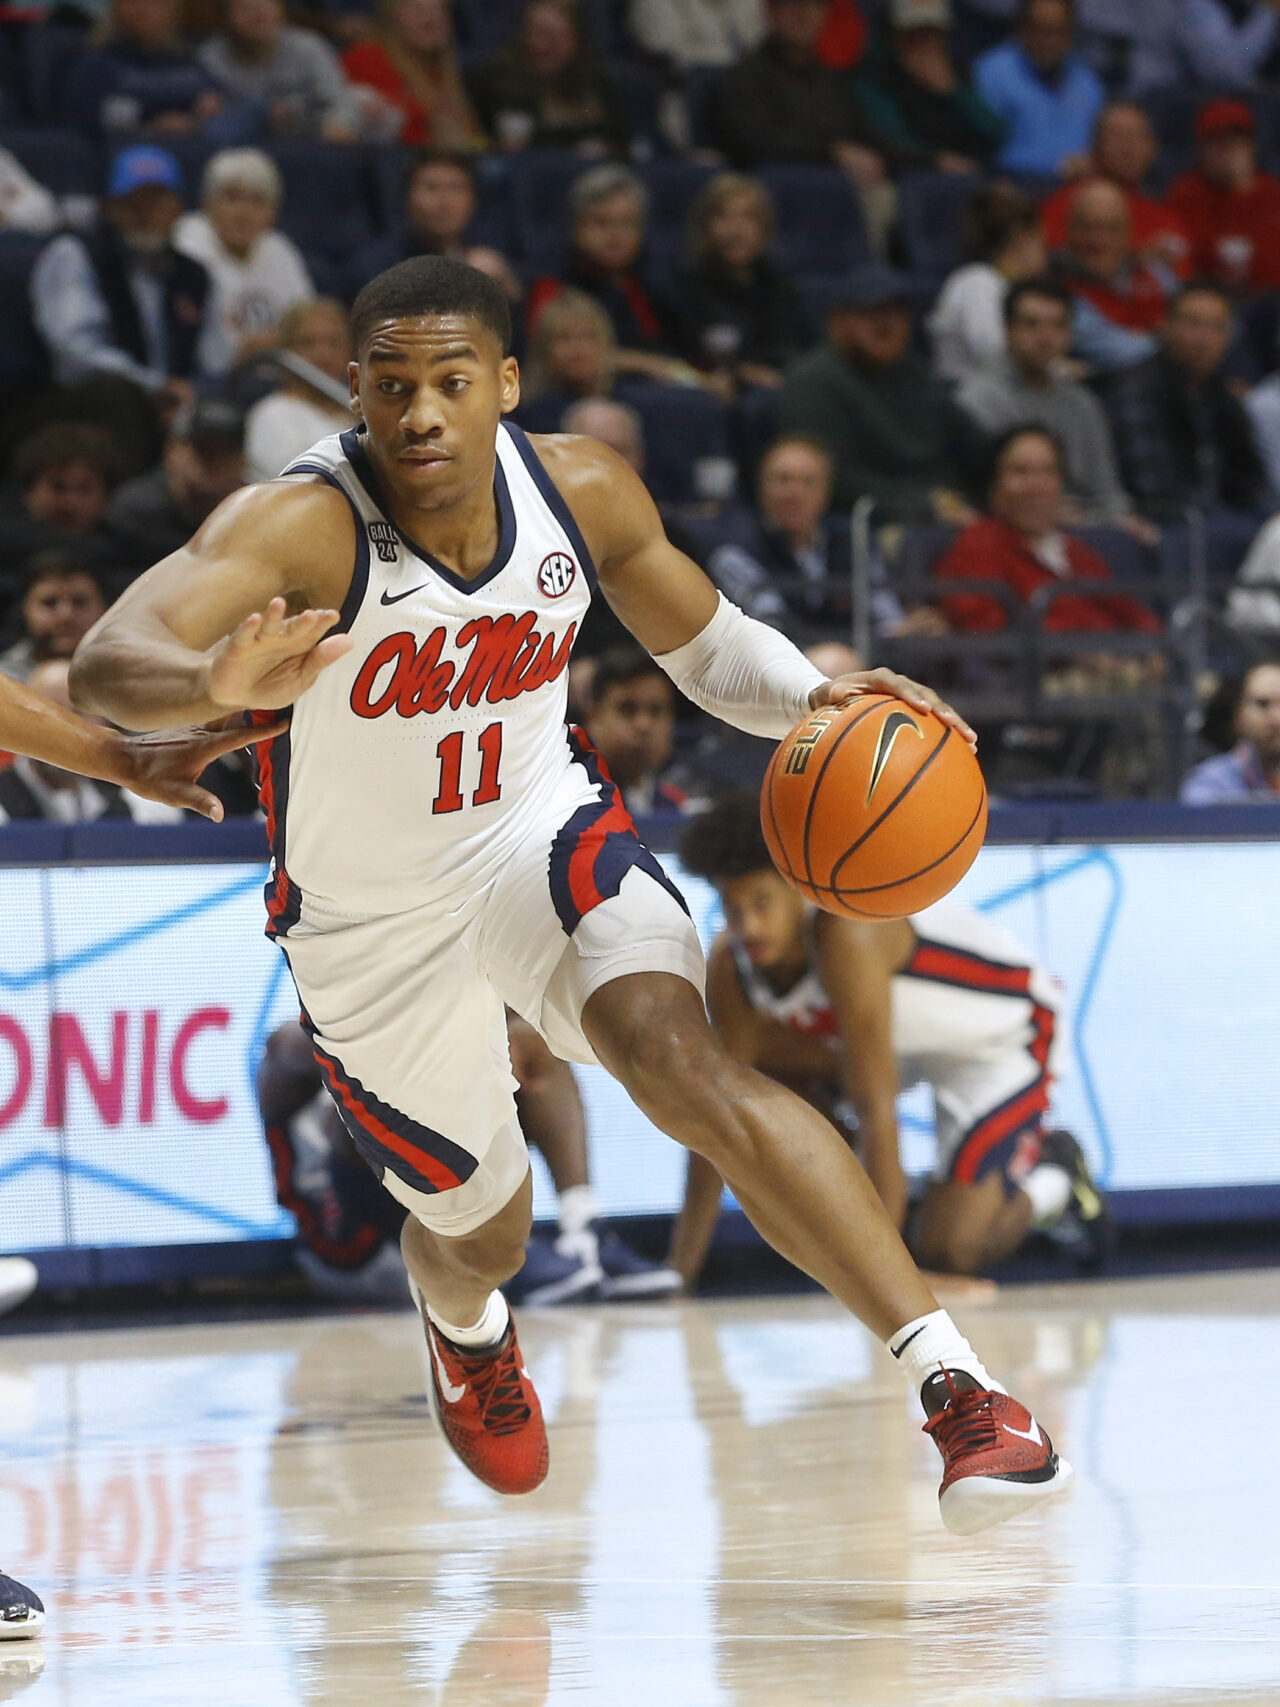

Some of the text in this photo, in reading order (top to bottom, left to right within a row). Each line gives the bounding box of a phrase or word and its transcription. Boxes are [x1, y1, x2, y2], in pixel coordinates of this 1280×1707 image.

[377, 542, 395, 560] 24
[539, 554, 574, 597] SEC
[350, 610, 577, 719] Ole Miss
[432, 721, 503, 815] 11
